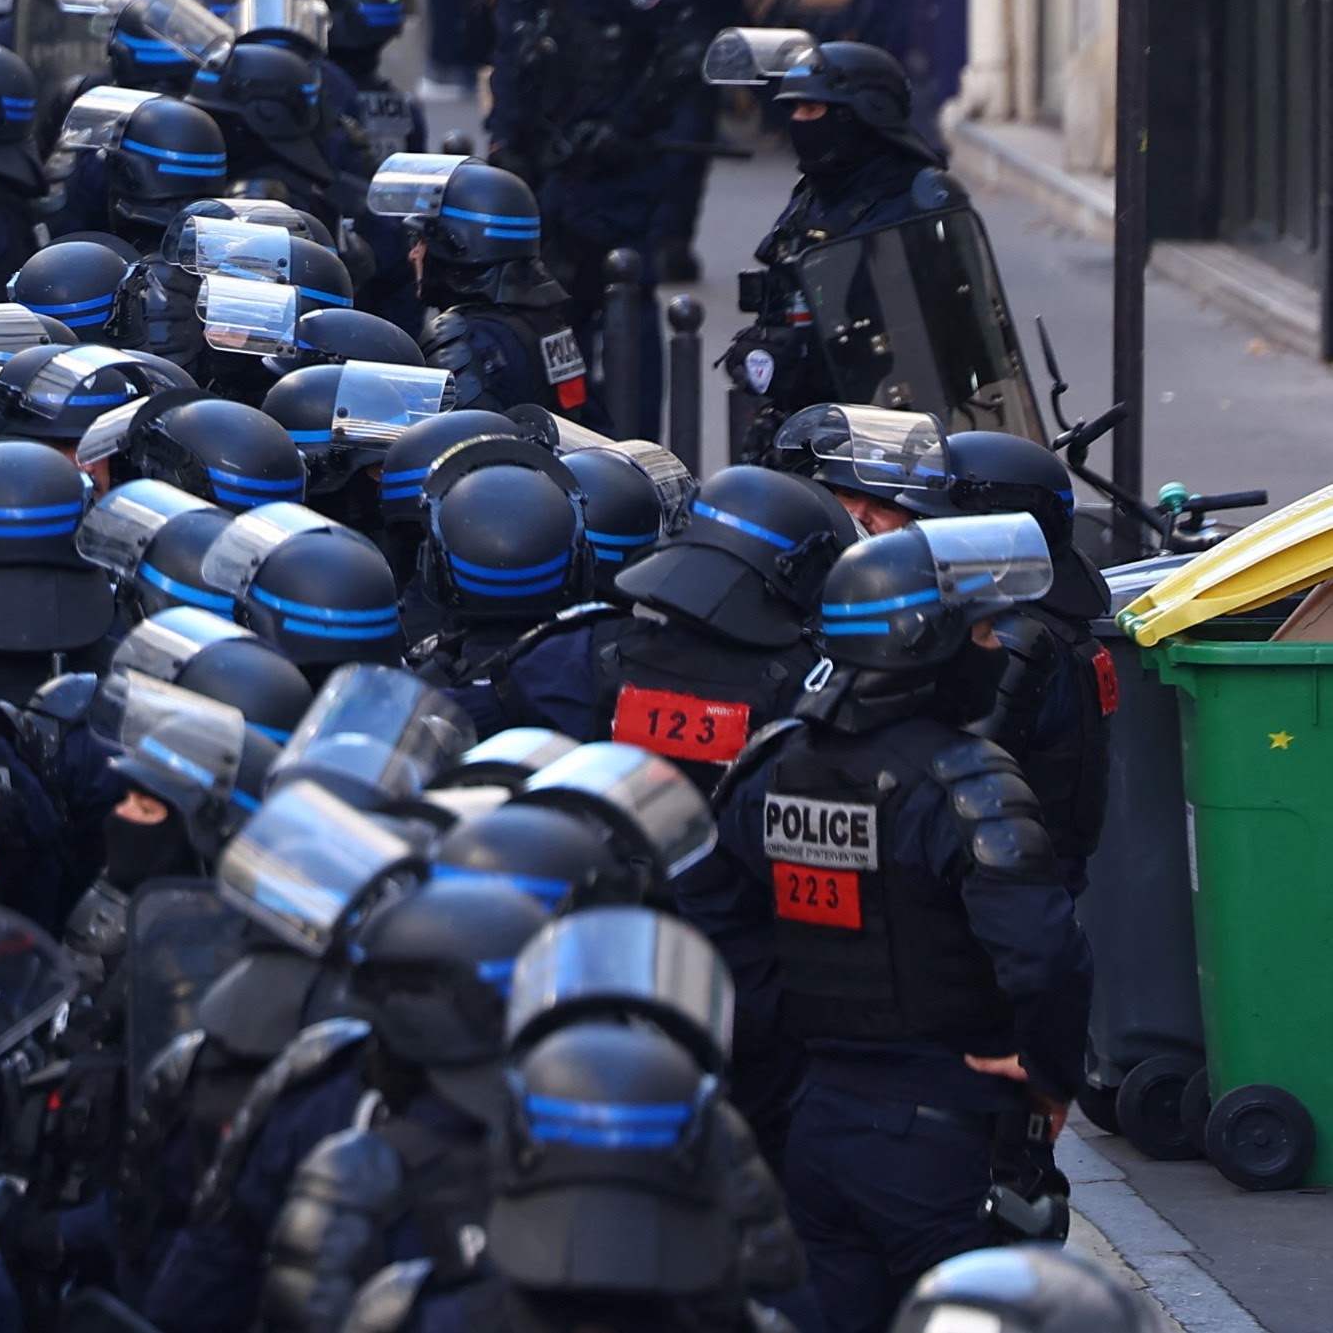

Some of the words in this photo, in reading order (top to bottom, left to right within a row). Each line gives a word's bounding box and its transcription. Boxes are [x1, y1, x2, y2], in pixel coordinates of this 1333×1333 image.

[648, 709, 715, 745] 123
[766, 801, 870, 848] POLICE
[789, 872, 839, 909] 223
